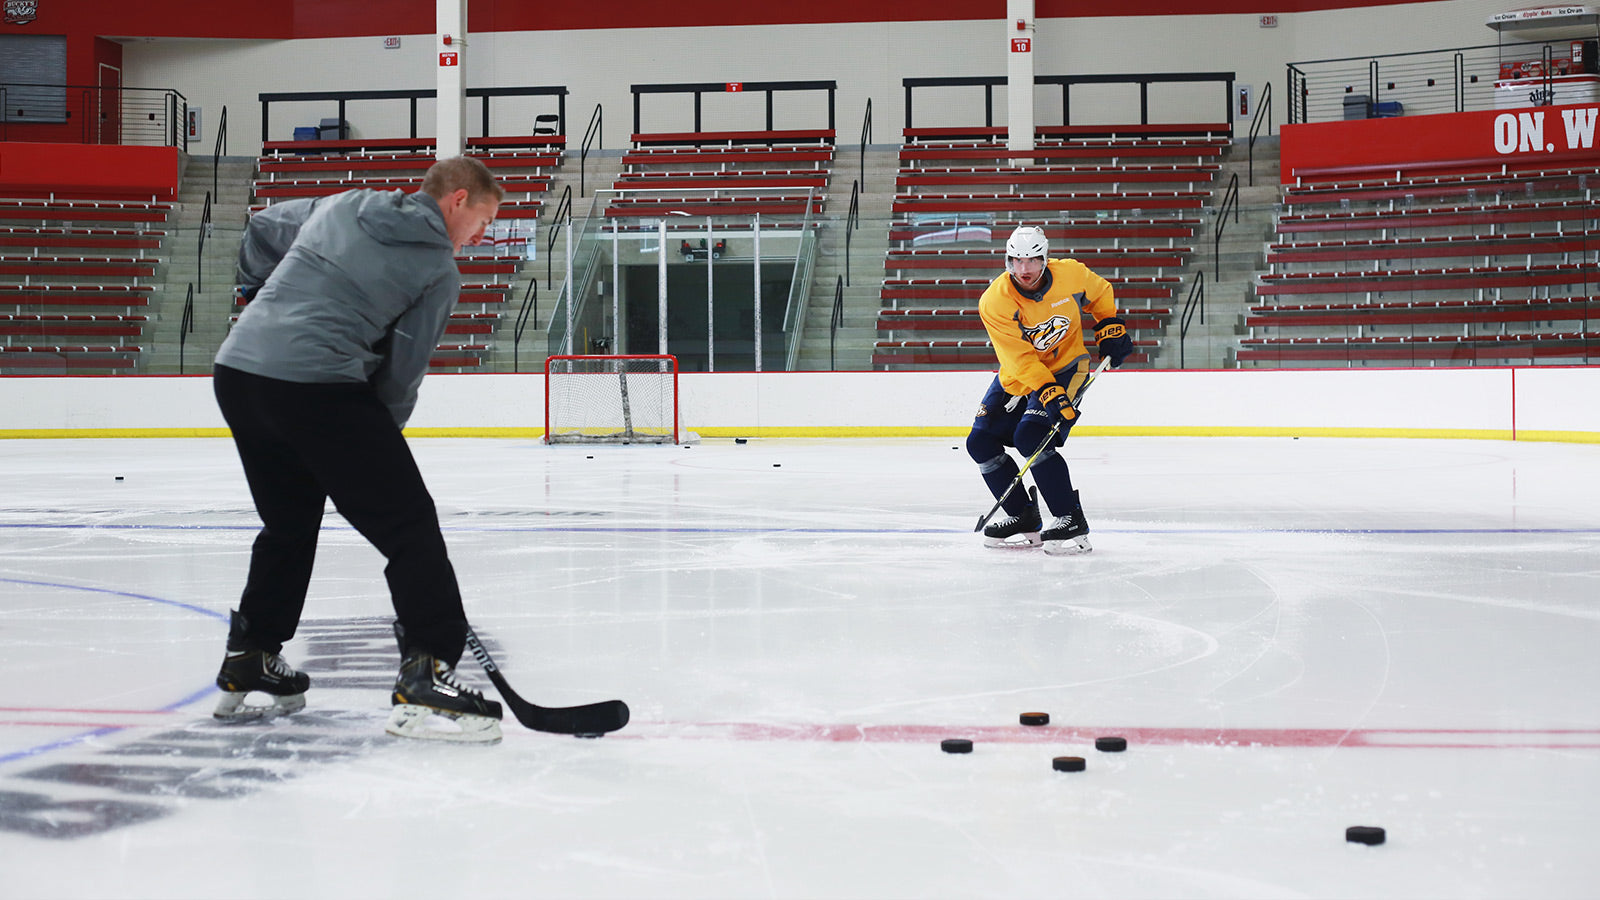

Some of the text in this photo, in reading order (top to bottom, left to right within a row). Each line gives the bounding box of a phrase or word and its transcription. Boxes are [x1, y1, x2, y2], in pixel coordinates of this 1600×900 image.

[1016, 43, 1026, 51] 10
[445, 57, 451, 65] 8
[1051, 297, 1070, 308] Reebok
